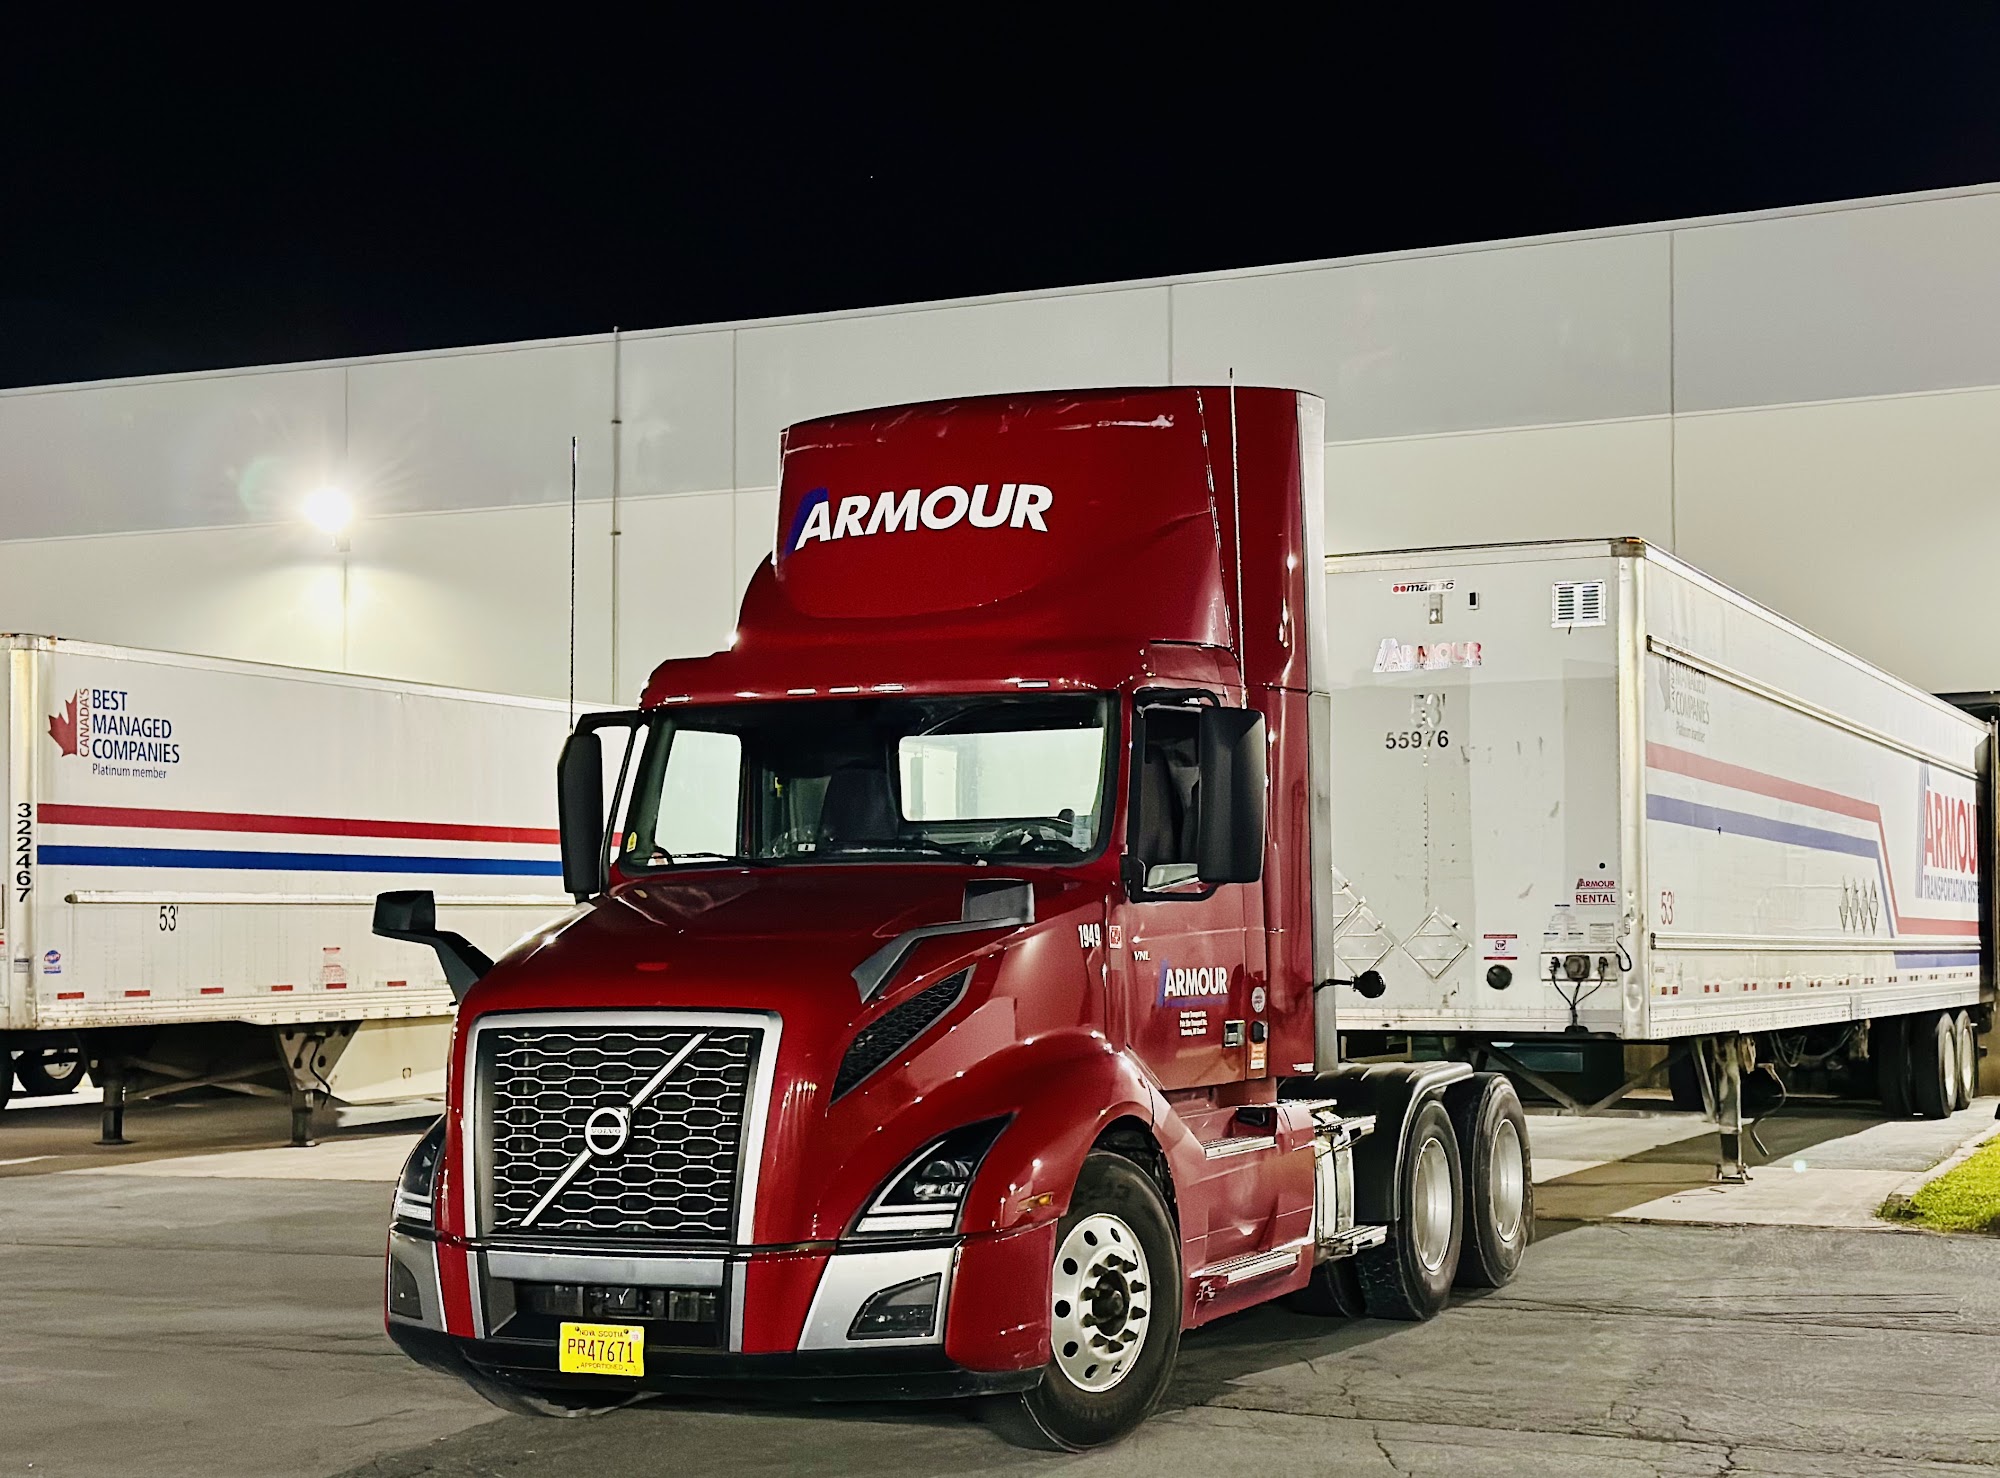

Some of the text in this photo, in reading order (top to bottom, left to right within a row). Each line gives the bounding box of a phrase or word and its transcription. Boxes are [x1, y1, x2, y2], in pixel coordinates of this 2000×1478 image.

[794, 483, 1053, 551] ARMOUR
[92, 688, 128, 711] BEST
[79, 687, 90, 757] CANADA'S
[92, 713, 172, 739] MANAGED
[92, 738, 180, 764] COMPANIES
[1385, 729, 1449, 749] 55976
[92, 762, 167, 779] Platinum member
[1924, 790, 1978, 876] ARMOU
[16, 802, 32, 903] 322467
[1575, 878, 1616, 889] ARMOUR
[1575, 894, 1616, 904] RENTAL
[1660, 891, 1675, 925] 53'
[159, 905, 179, 932] 53'
[1077, 923, 1101, 948] 1949
[1133, 950, 1151, 961] VNL
[1164, 966, 1228, 997] ARMOUR
[598, 1330, 624, 1338] SCOTIA
[567, 1338, 635, 1363] PR47671
